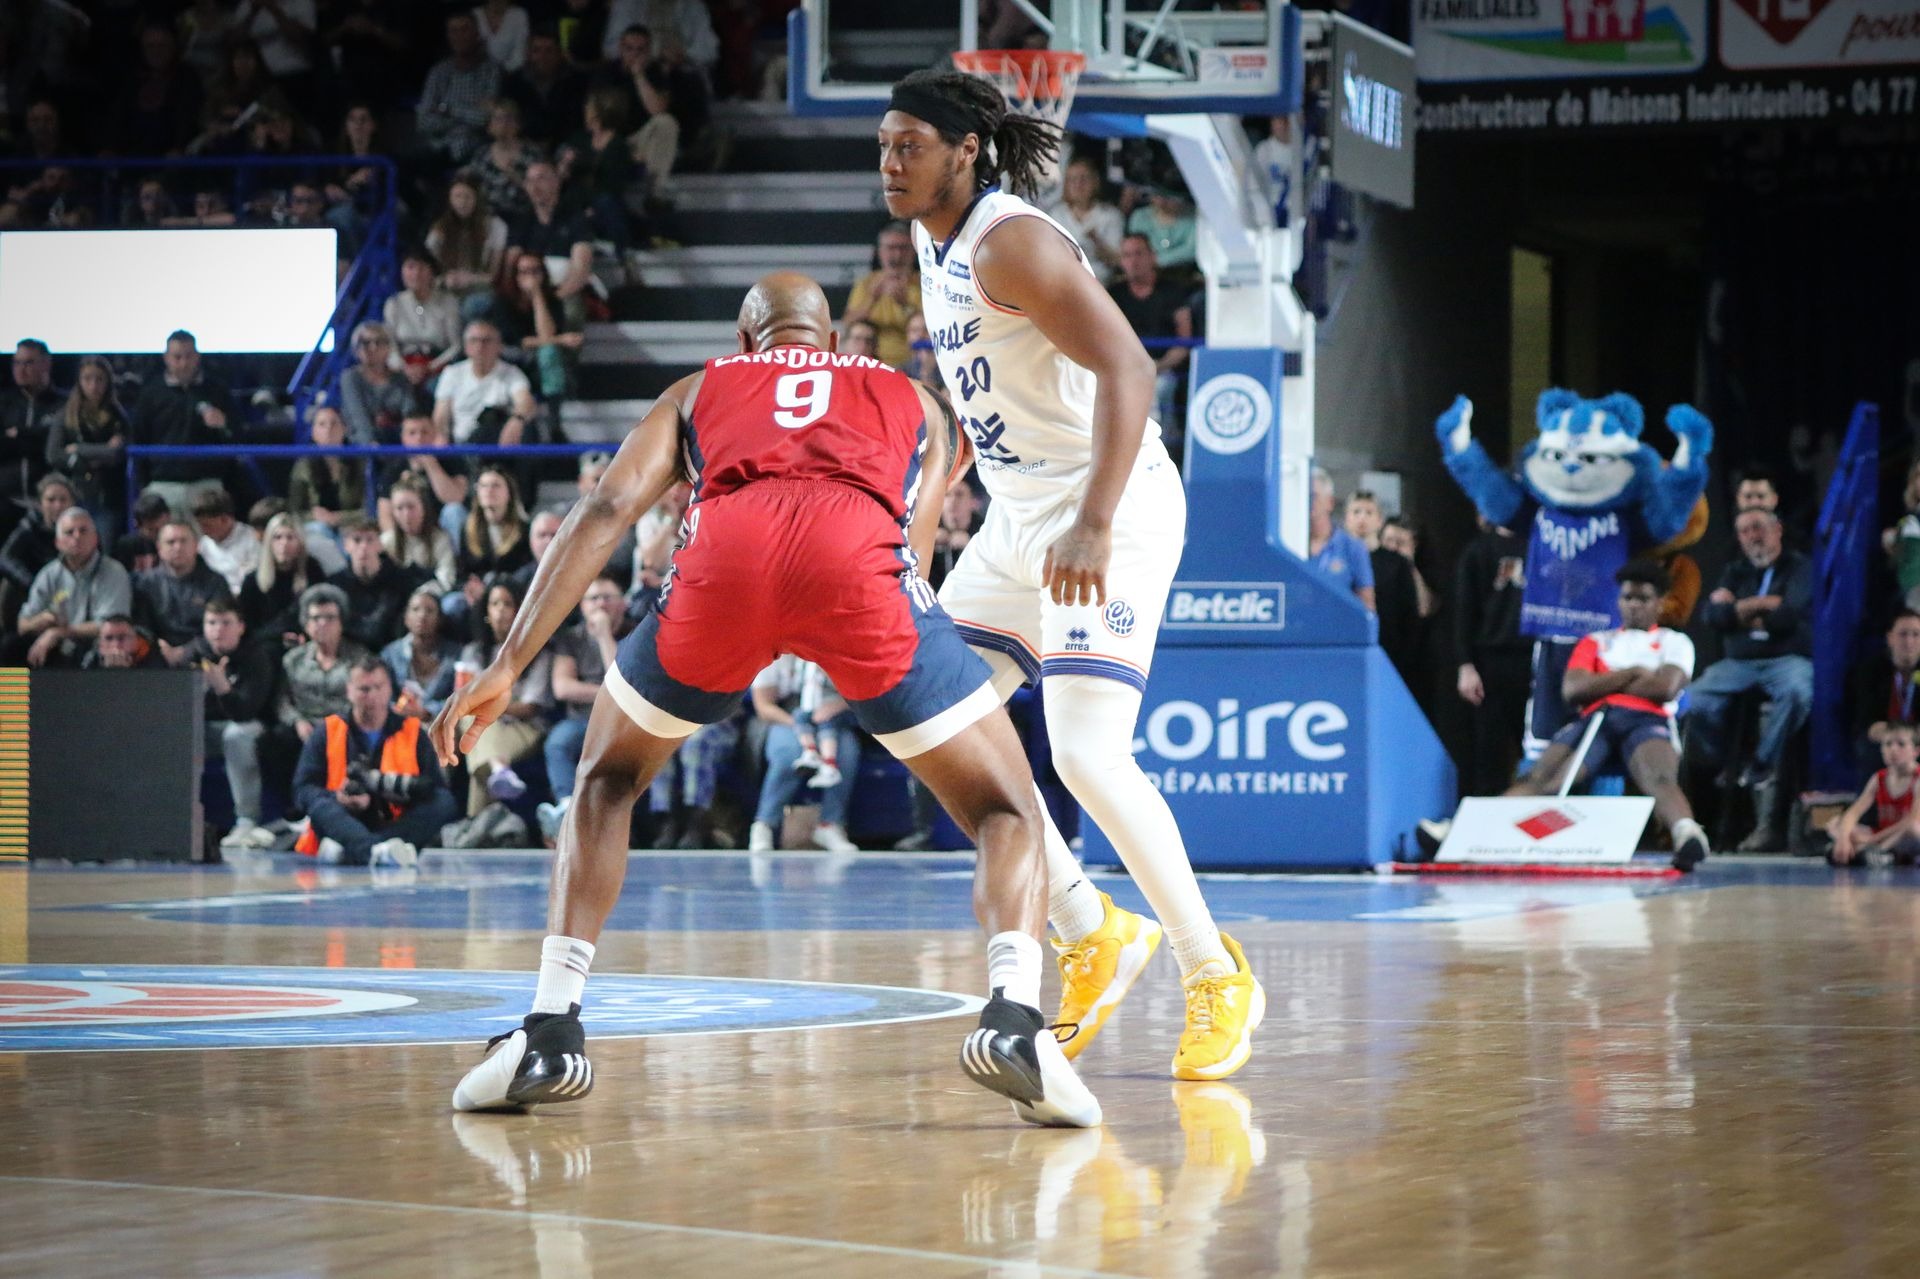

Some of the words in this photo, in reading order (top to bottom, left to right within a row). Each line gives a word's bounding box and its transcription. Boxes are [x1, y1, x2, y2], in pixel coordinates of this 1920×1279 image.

[1555, 88, 1584, 127] de
[1588, 86, 1682, 125] Maisons
[1686, 80, 1830, 121] Individuelles
[1852, 77, 1883, 116] 04
[1888, 76, 1918, 115] 77
[773, 370, 833, 429] 9
[956, 356, 991, 401] 20
[690, 507, 701, 546] 9
[1170, 591, 1274, 623] Betclic
[1065, 642, 1090, 652] errea
[1133, 699, 1349, 760] oire
